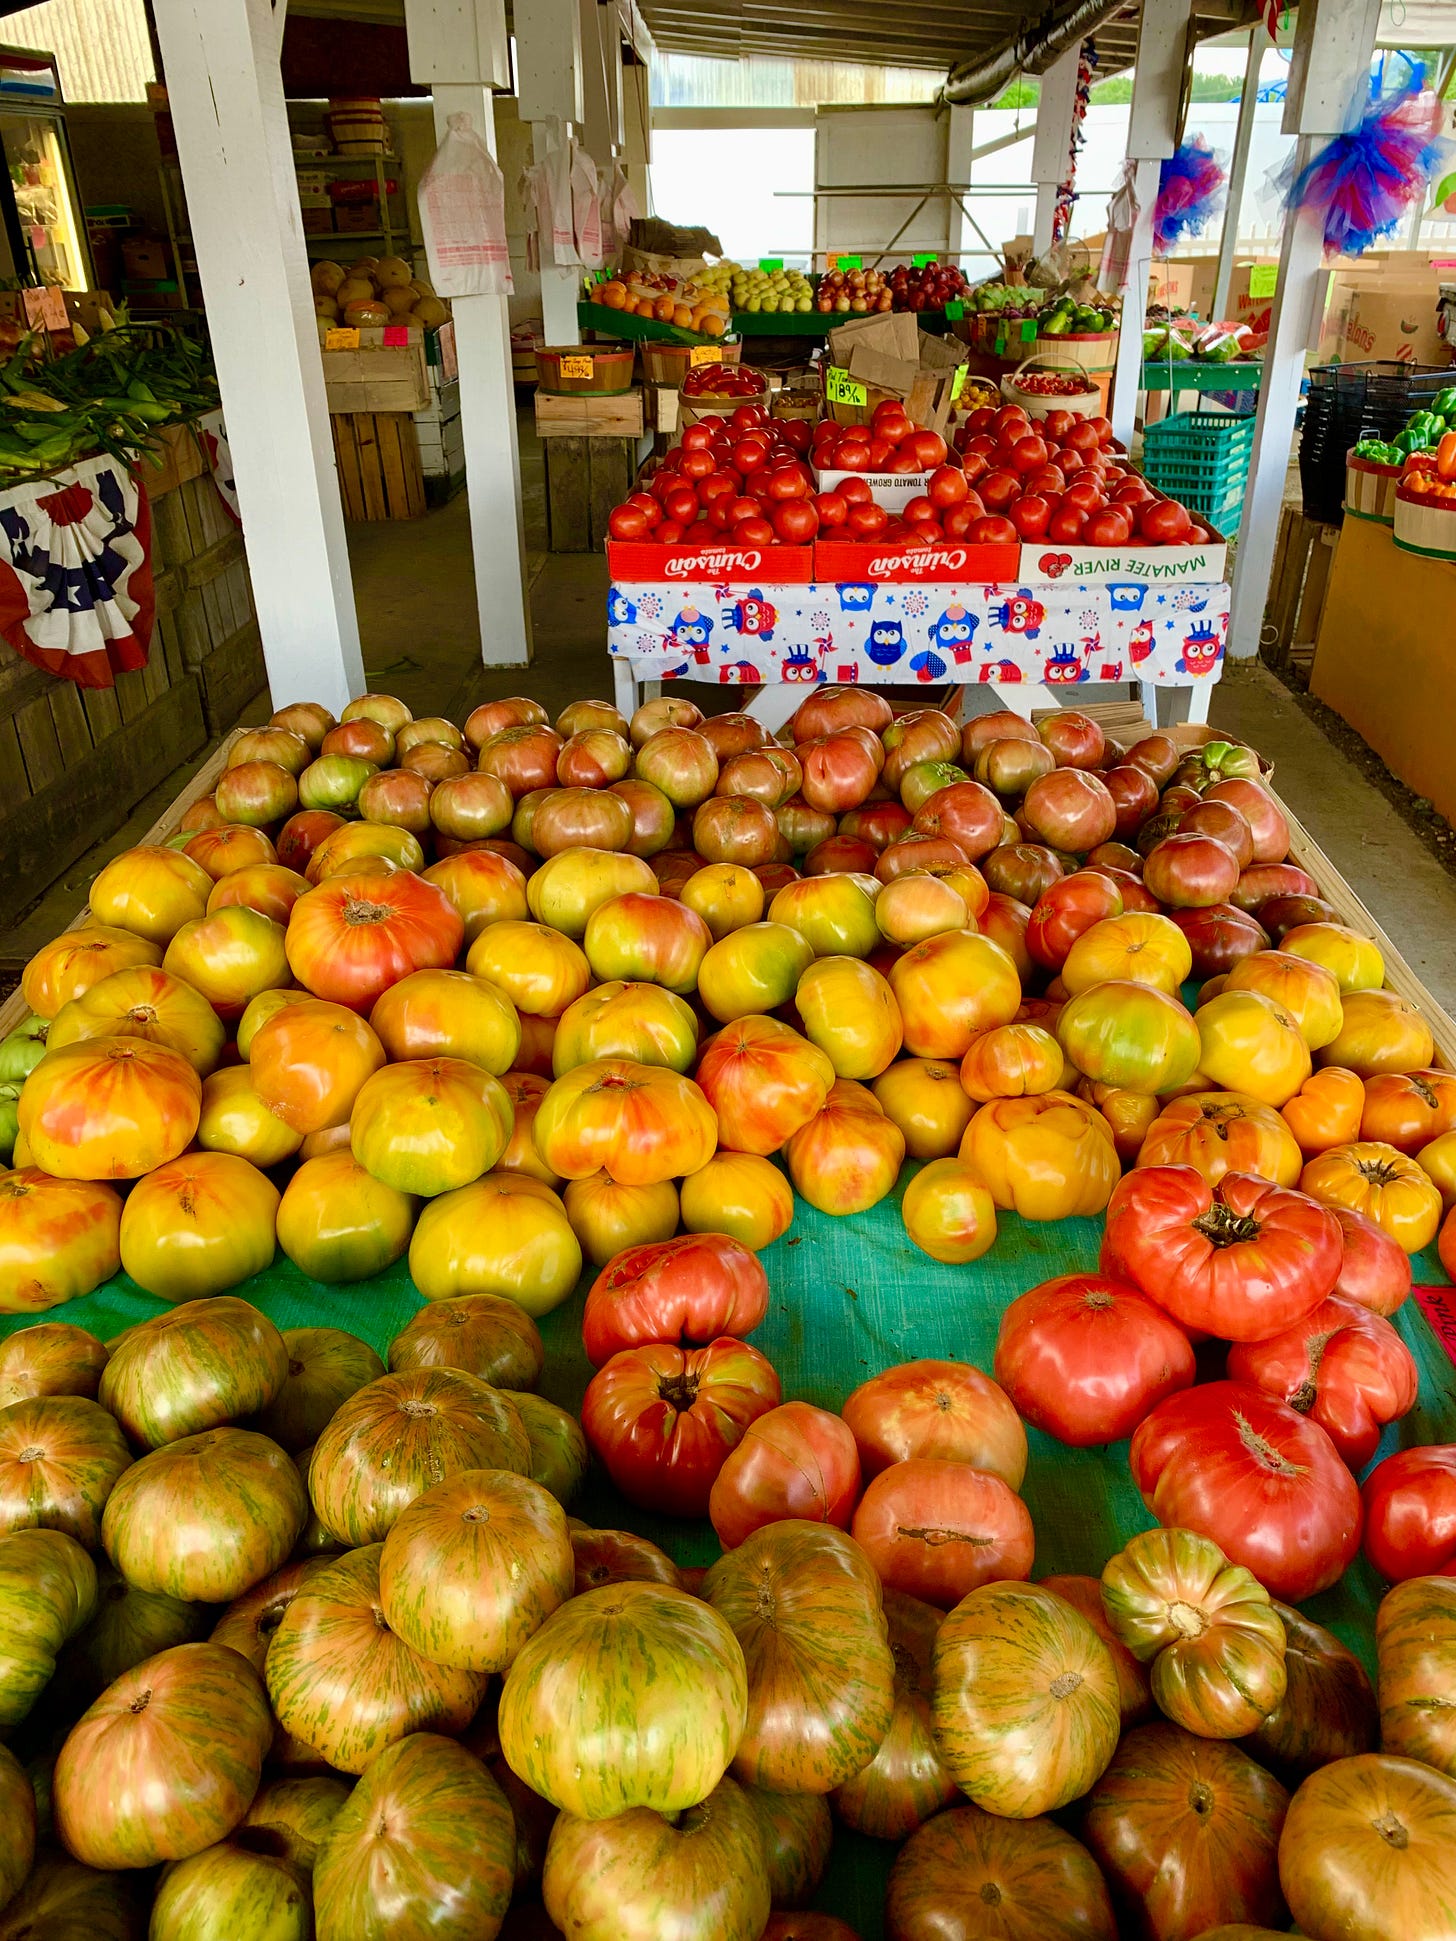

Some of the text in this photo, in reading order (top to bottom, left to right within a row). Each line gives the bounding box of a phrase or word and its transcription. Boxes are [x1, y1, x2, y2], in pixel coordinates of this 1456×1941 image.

[864, 478, 893, 487] GROWE
[894, 478, 921, 487] TOMATO
[700, 547, 726, 556] tomato
[905, 546, 932, 555] tomato
[664, 550, 762, 578] Crimson
[867, 549, 967, 578] Crimson
[1073, 555, 1207, 578] MANATEE RIVER
[706, 568, 720, 576] The
[910, 567, 924, 575] The
